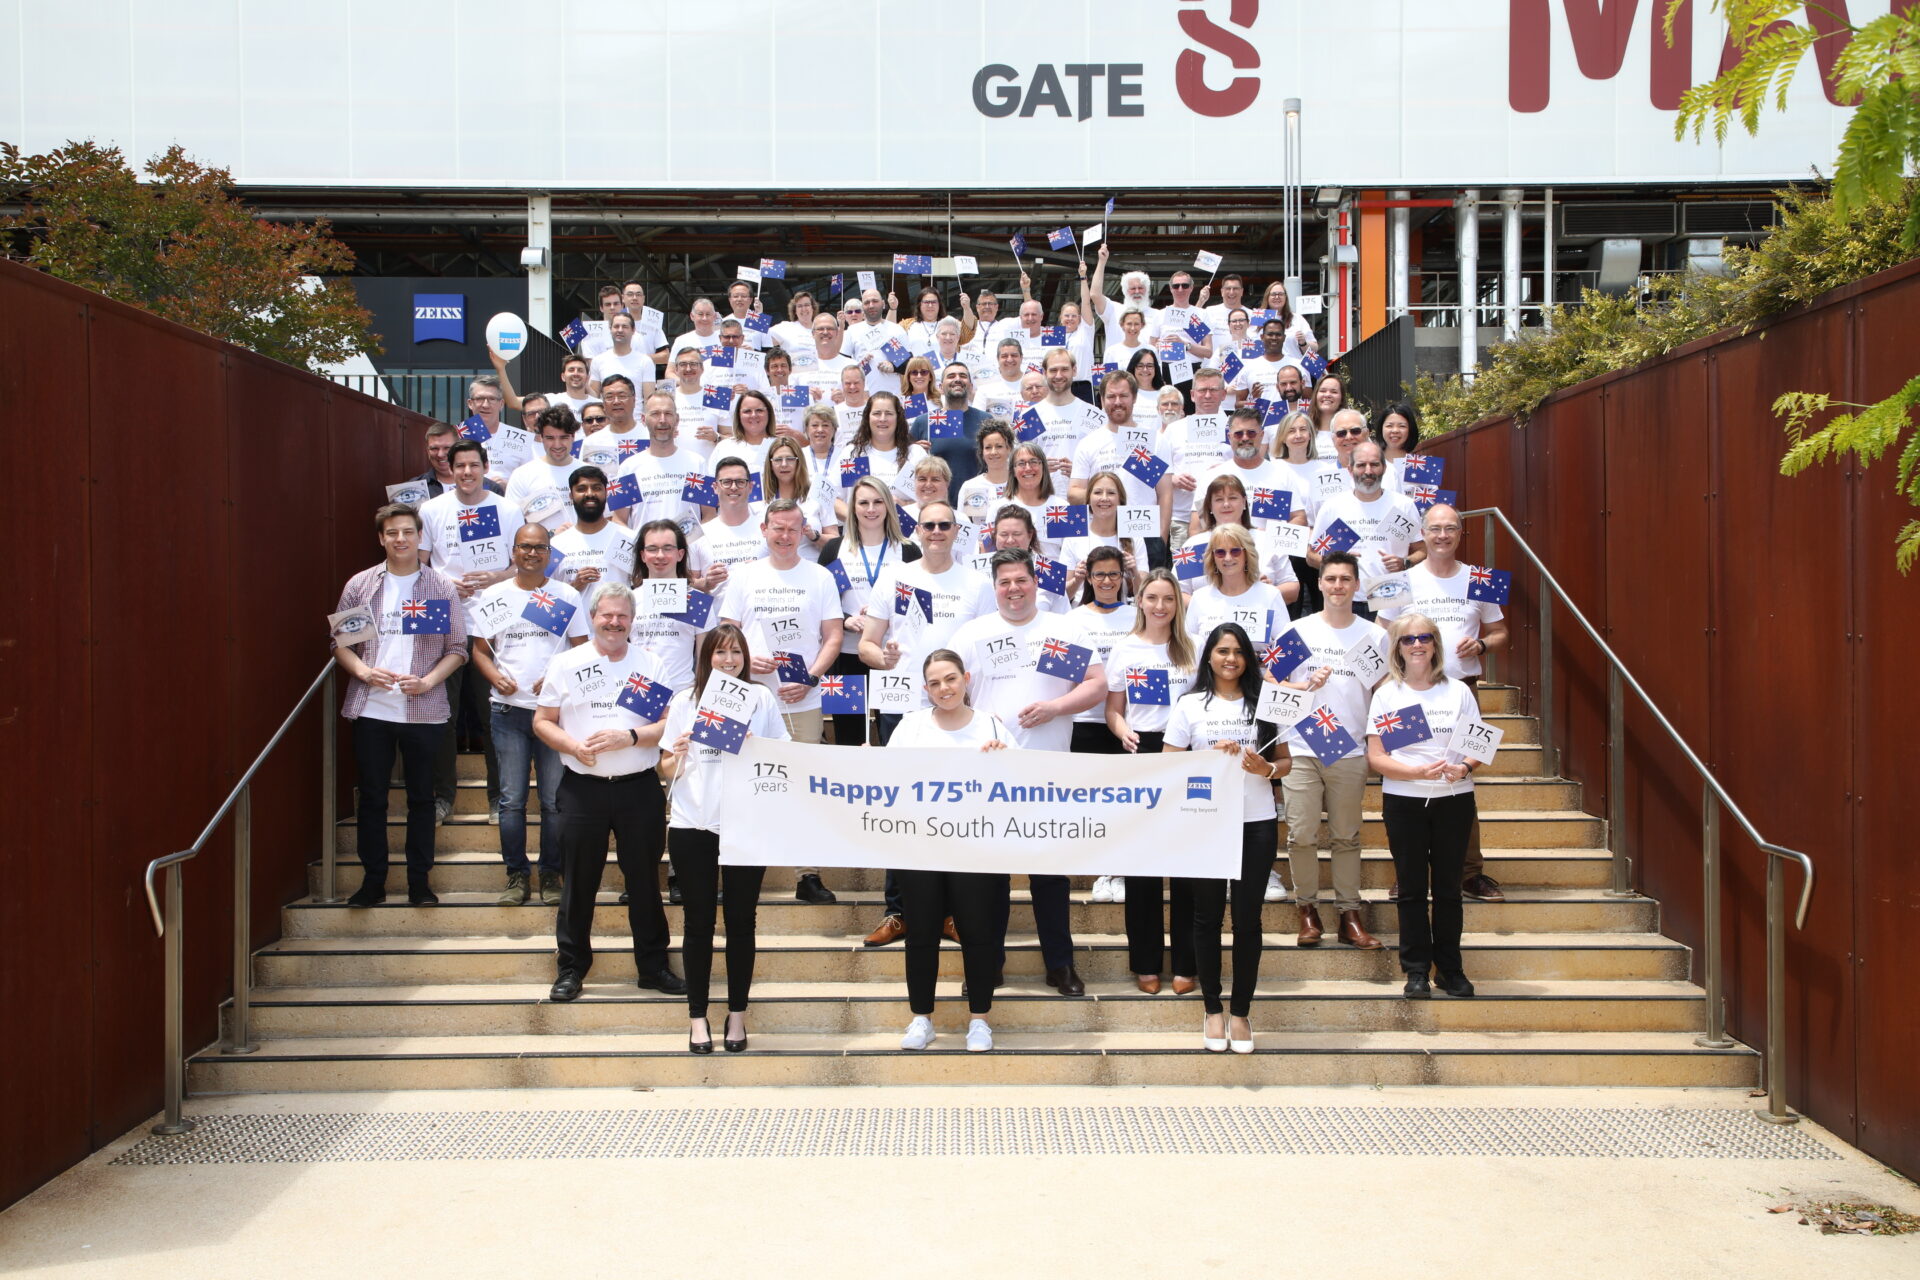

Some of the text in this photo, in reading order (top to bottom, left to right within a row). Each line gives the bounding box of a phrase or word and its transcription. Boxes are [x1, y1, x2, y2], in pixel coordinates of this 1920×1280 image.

[972, 64, 1145, 122] GATE
[861, 273, 872, 281] 175
[415, 307, 462, 319] ZEISS
[647, 309, 660, 320] 175
[1170, 309, 1186, 319] 175
[588, 323, 603, 332] 175
[1009, 331, 1025, 339] 175
[743, 352, 760, 362] 175
[965, 353, 980, 364] 175
[1173, 361, 1188, 371] 175
[1085, 408, 1106, 425] 175
[1195, 417, 1217, 428] 175
[506, 430, 527, 444] 175
[1127, 430, 1149, 442] 175
[1196, 429, 1218, 439] years
[502, 439, 524, 452] years
[1318, 473, 1342, 485] 175
[820, 480, 836, 497] 175
[1319, 484, 1343, 496] years
[1126, 509, 1151, 521] 175
[1127, 522, 1152, 532] years
[1394, 514, 1414, 534] 175
[1276, 526, 1300, 539] 175
[1385, 524, 1406, 542] years
[469, 542, 496, 556] 175
[620, 539, 635, 552] 17
[1274, 538, 1299, 550] years
[577, 549, 605, 557] challen
[472, 554, 498, 568] years
[971, 558, 993, 570] 17
[651, 583, 677, 595] 175
[768, 586, 806, 596] challenge
[479, 597, 508, 617] 175
[651, 596, 677, 608] years
[1431, 597, 1470, 606] challenge
[754, 605, 801, 614] imagination
[1430, 606, 1451, 614] limits
[1452, 605, 1460, 613] of
[486, 608, 513, 628] years
[1233, 611, 1258, 623] 175
[1432, 615, 1466, 624] gination
[771, 618, 799, 632] 175
[504, 630, 549, 640] magination
[775, 632, 802, 646] years
[986, 636, 1016, 653] 175
[991, 649, 1019, 669] years
[1363, 645, 1384, 670] 175
[575, 664, 603, 682] 175
[1353, 655, 1374, 678] years
[579, 679, 606, 696] years
[881, 675, 911, 690] 175
[719, 679, 749, 702] 175
[712, 693, 742, 713] years
[880, 691, 910, 704] years
[1271, 690, 1302, 708] 175
[1267, 704, 1298, 719] years
[1206, 728, 1252, 736] the limits of
[1469, 723, 1494, 743] 175
[1462, 736, 1488, 754] years
[753, 762, 788, 779] 175
[753, 780, 788, 796] years
[809, 775, 1163, 810] Happy 175th Anniversary
[1187, 782, 1212, 790] ZEISS
[861, 812, 1107, 839] from South Australia
